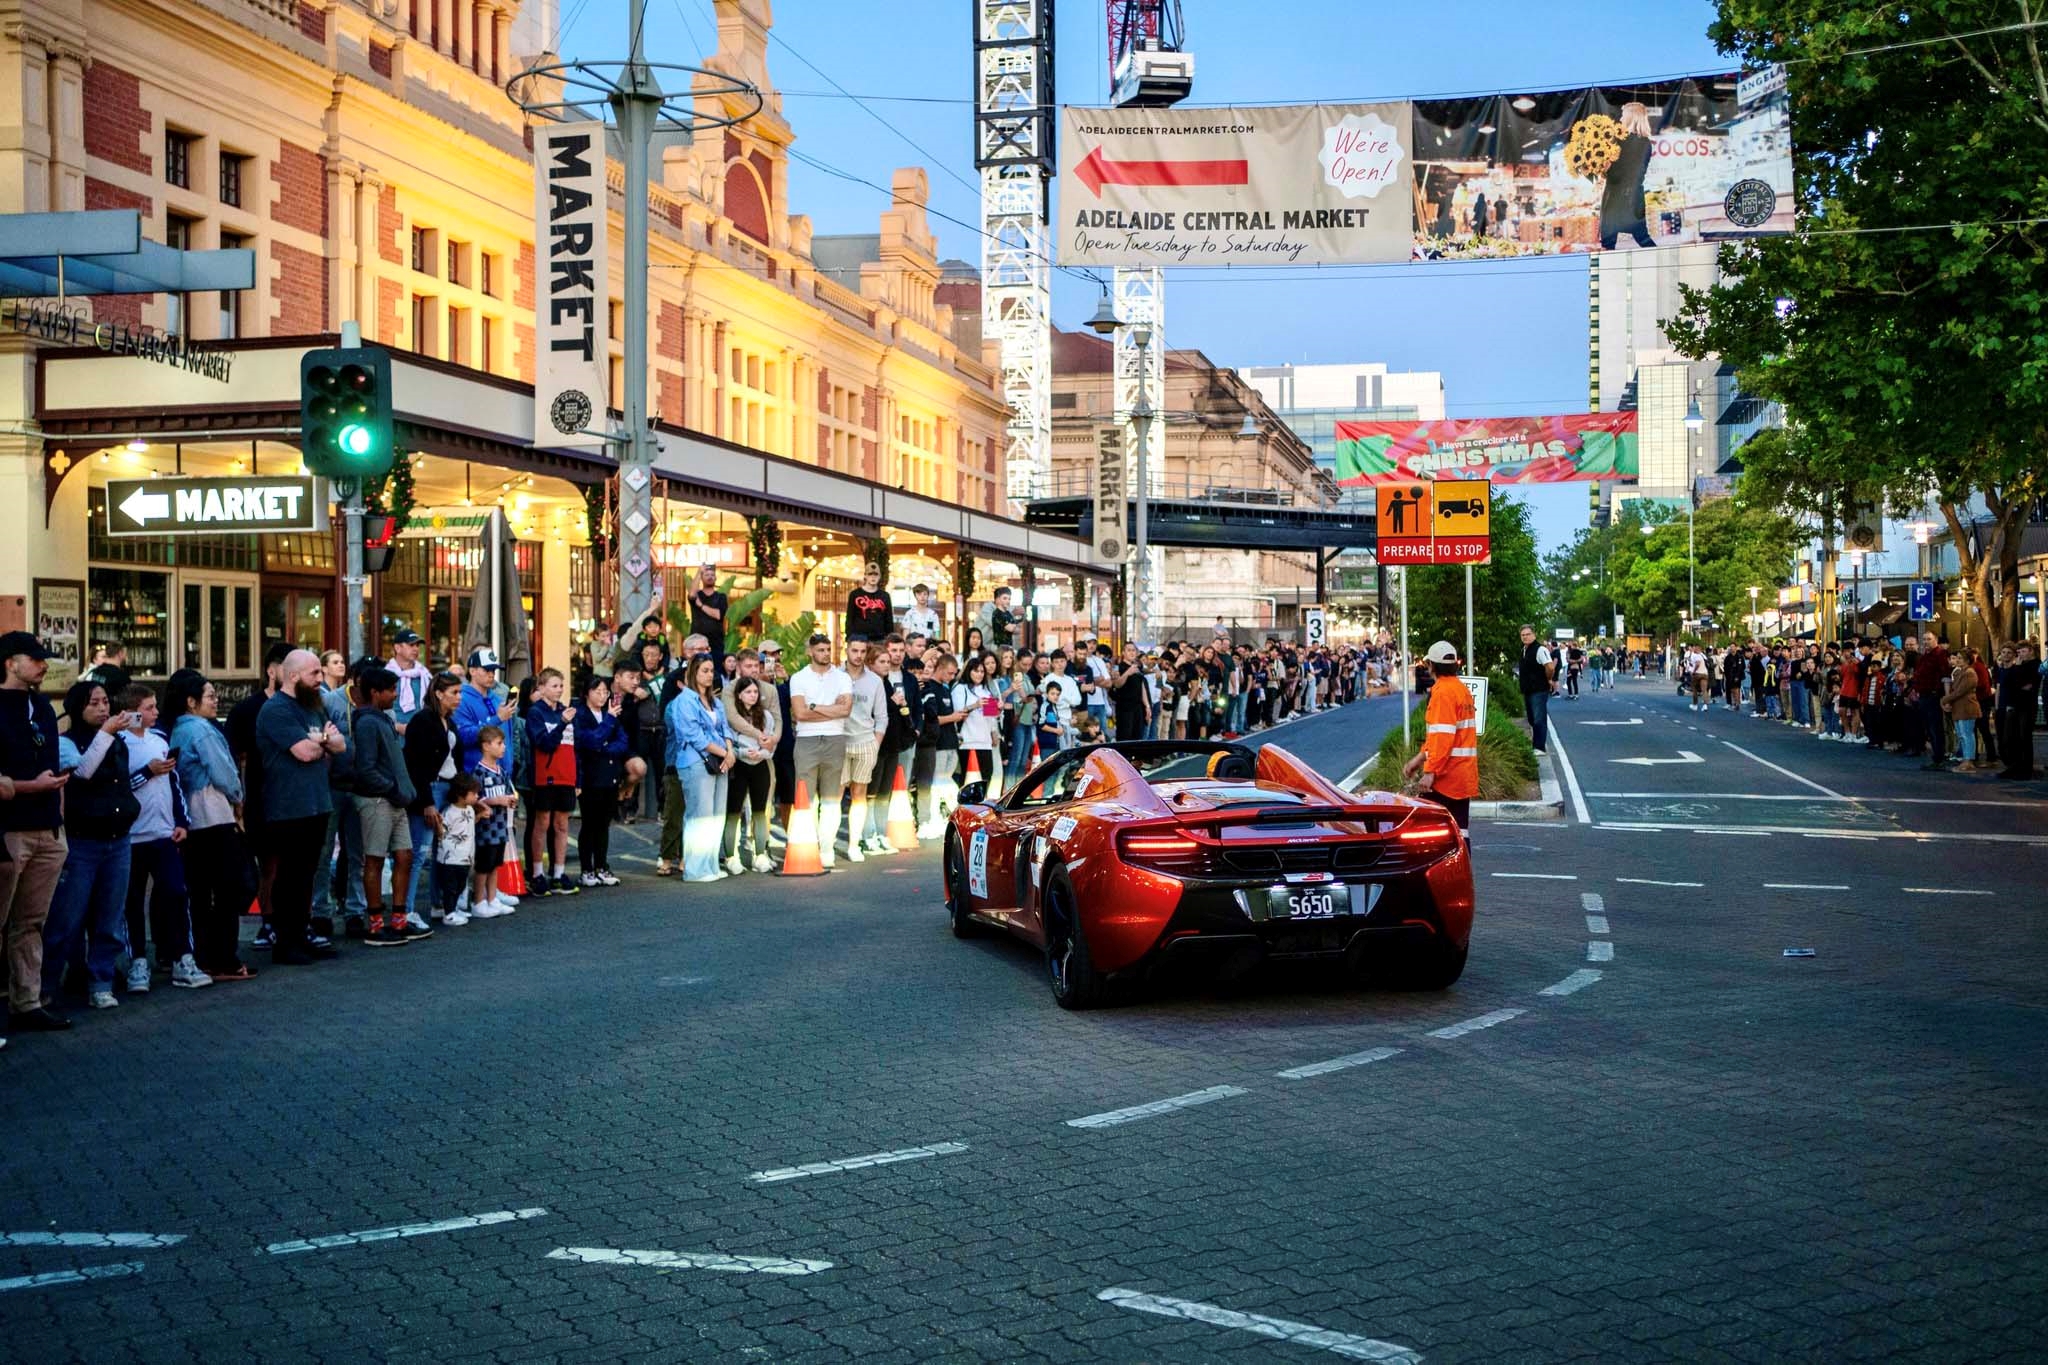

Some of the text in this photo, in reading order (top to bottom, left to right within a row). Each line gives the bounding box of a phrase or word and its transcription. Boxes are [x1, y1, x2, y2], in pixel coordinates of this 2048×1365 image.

[1078, 125, 1254, 135] ADELAIDECENTRALMARKET.COM
[1335, 128, 1388, 154] We're
[1331, 156, 1393, 184] Open!
[1075, 208, 1370, 231] ADELAIDE CENTRAL MARKET
[549, 134, 594, 361] MARKET
[1075, 231, 1309, 261] Open Tuesday to Saturday
[1442, 441, 1465, 450] Have
[1473, 437, 1508, 447] cracker
[1406, 440, 1566, 472] CHRISTMAS
[1100, 429, 1121, 528] MARKET
[175, 485, 304, 522] MARKET
[1383, 544, 1483, 557] PREPARE TO STOP
[1916, 587, 1927, 601] P
[1310, 618, 1322, 639] 3
[973, 843, 984, 867] 28
[1288, 894, 1333, 915] S650
